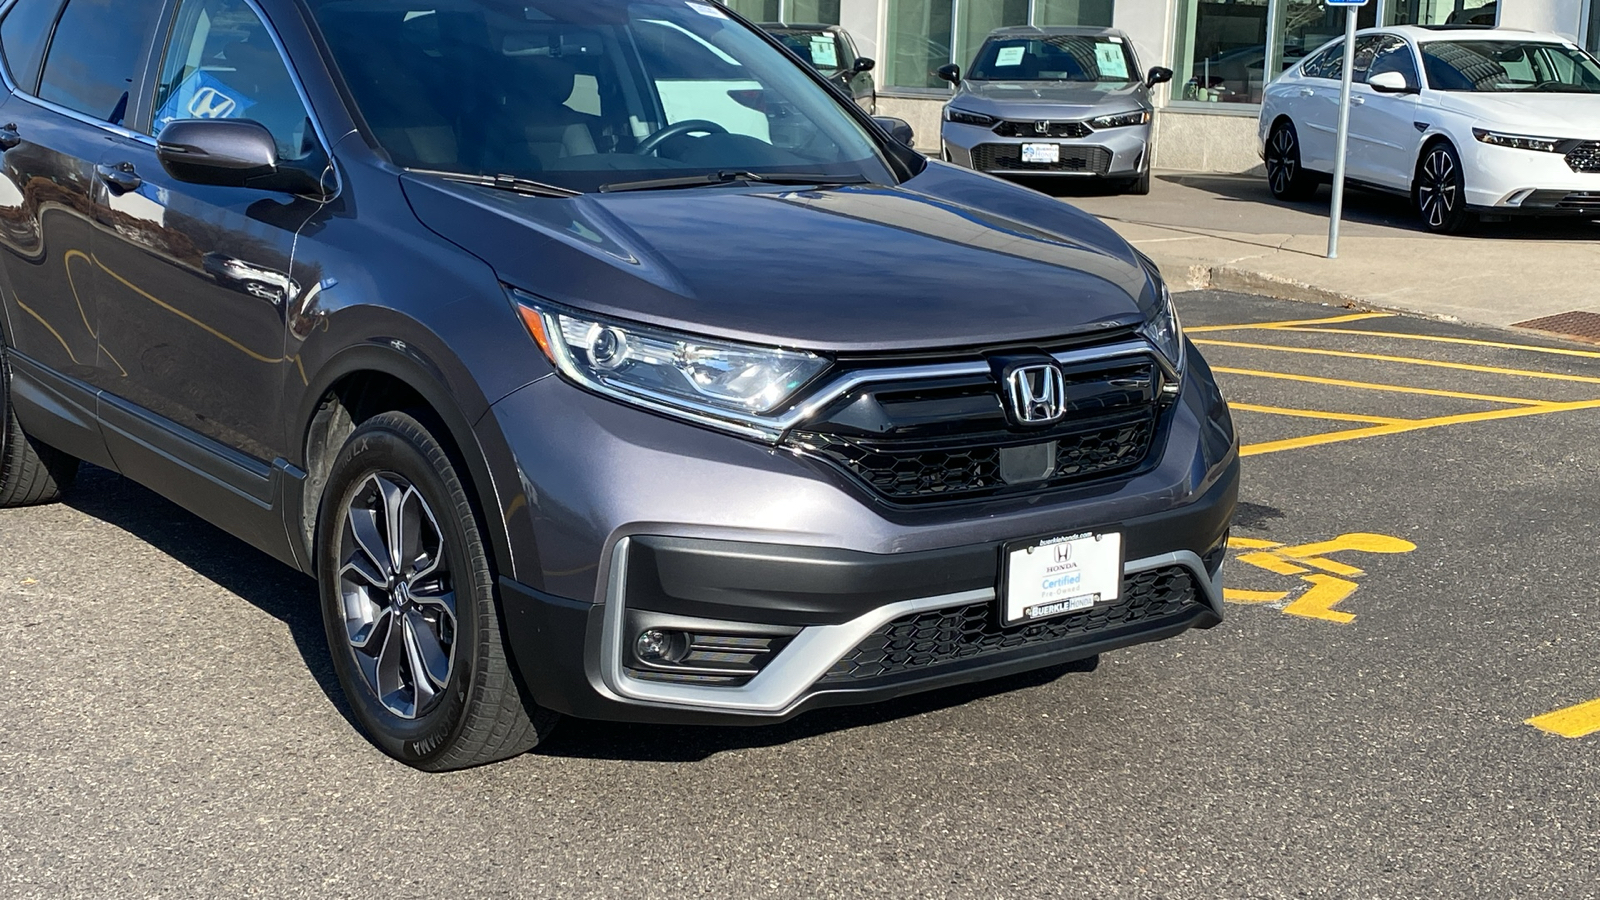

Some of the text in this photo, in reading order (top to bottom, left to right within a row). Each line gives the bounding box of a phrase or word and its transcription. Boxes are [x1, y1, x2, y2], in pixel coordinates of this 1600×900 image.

[1046, 562, 1078, 573] HONDA
[1042, 573, 1081, 589] Certified
[1041, 585, 1081, 598] Pre-Owned
[1032, 597, 1092, 616] BUERKLE HONDA
